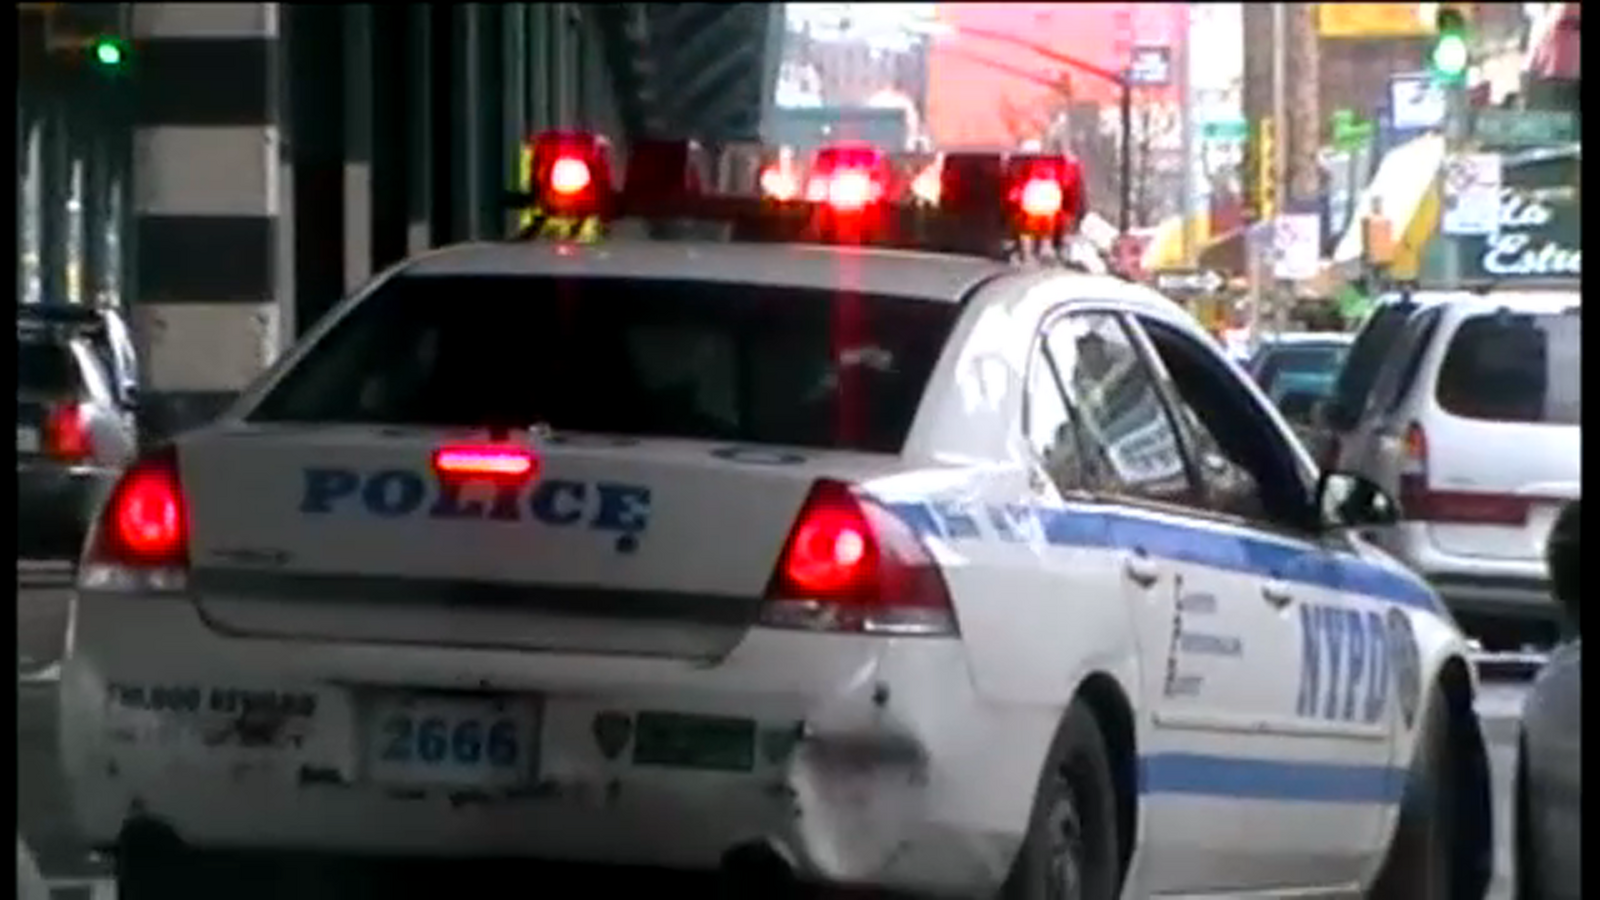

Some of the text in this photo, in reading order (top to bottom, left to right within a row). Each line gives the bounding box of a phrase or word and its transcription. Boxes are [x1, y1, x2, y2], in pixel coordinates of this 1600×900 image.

[298, 467, 651, 531] POLICE
[1296, 601, 1388, 725] NYPD
[381, 714, 519, 767] 2666
